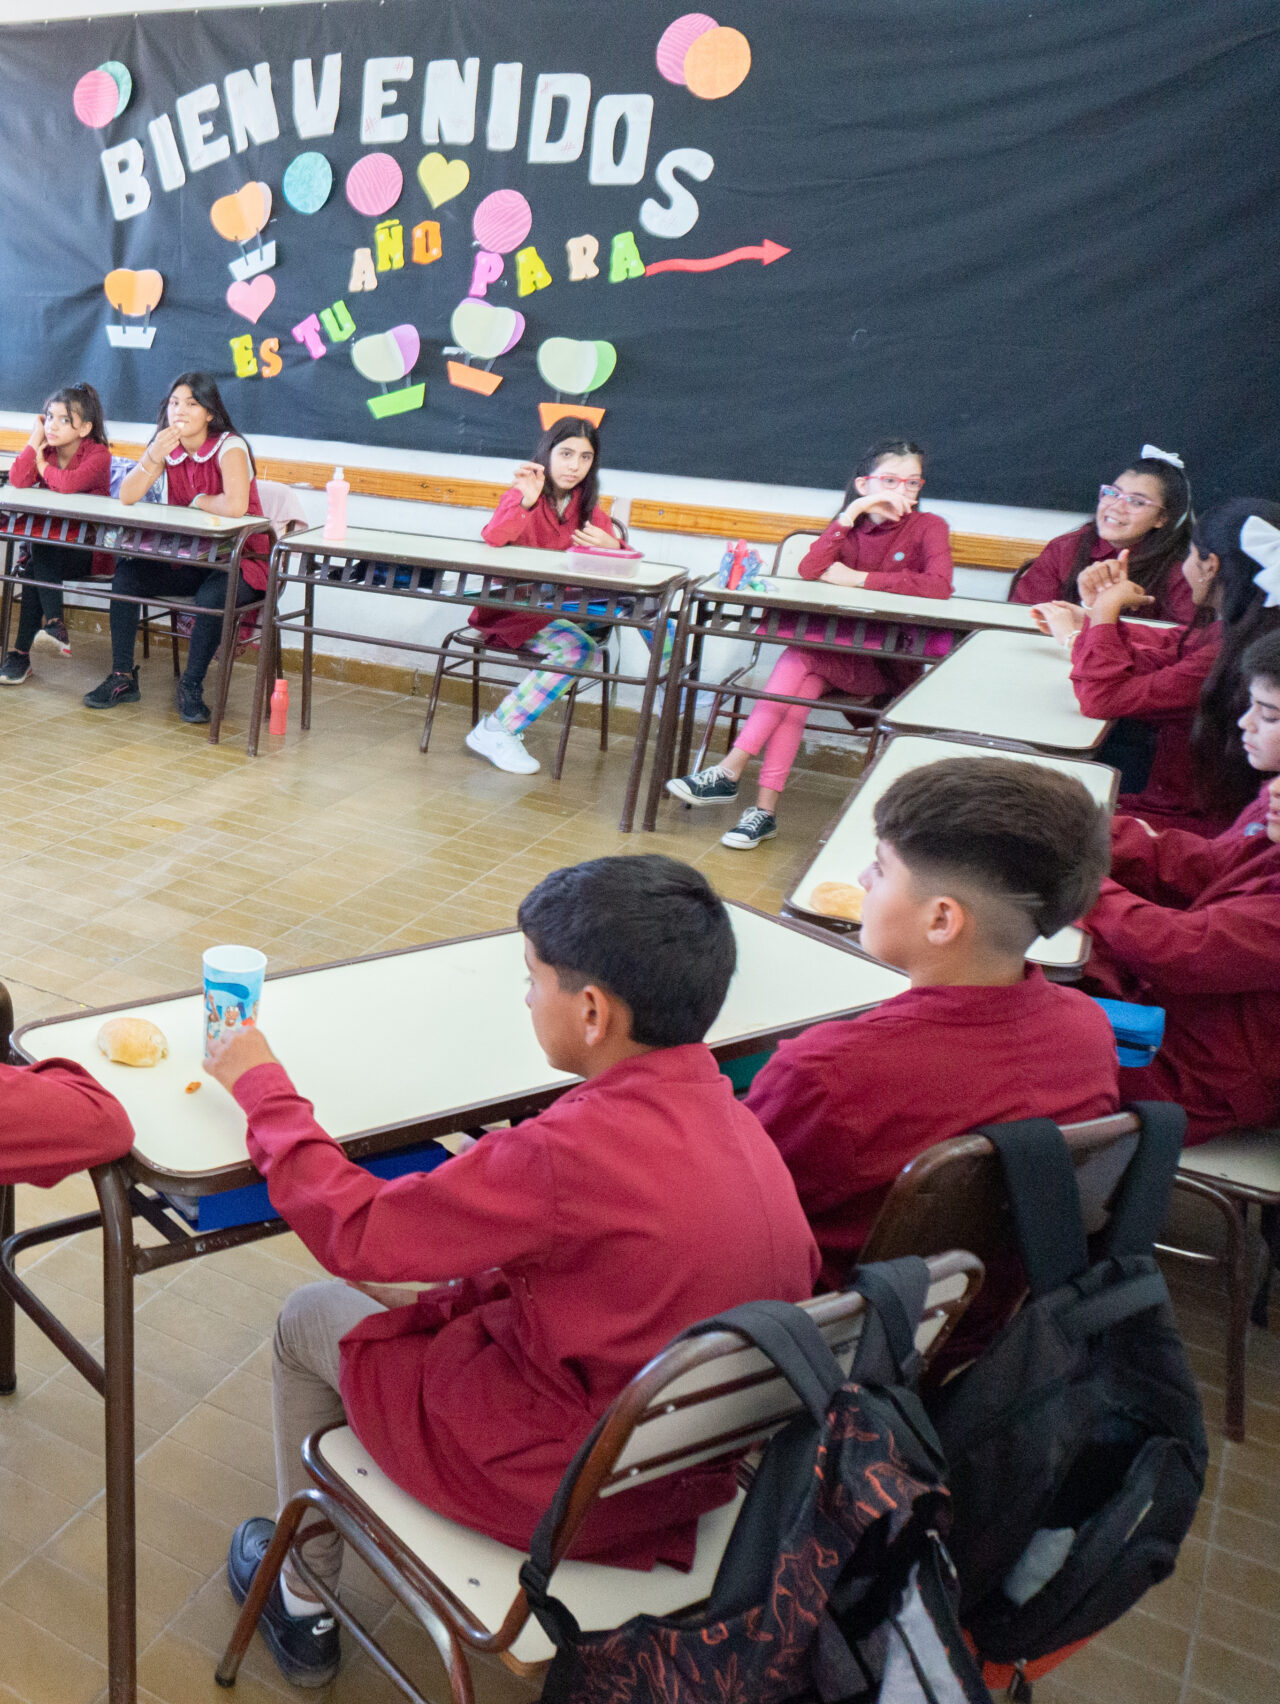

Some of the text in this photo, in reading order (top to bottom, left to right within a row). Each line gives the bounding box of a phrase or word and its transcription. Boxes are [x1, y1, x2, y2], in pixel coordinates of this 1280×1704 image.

[100, 53, 715, 239] BIENVENIDOS
[230, 219, 646, 378] ES TU AÑO PARA
